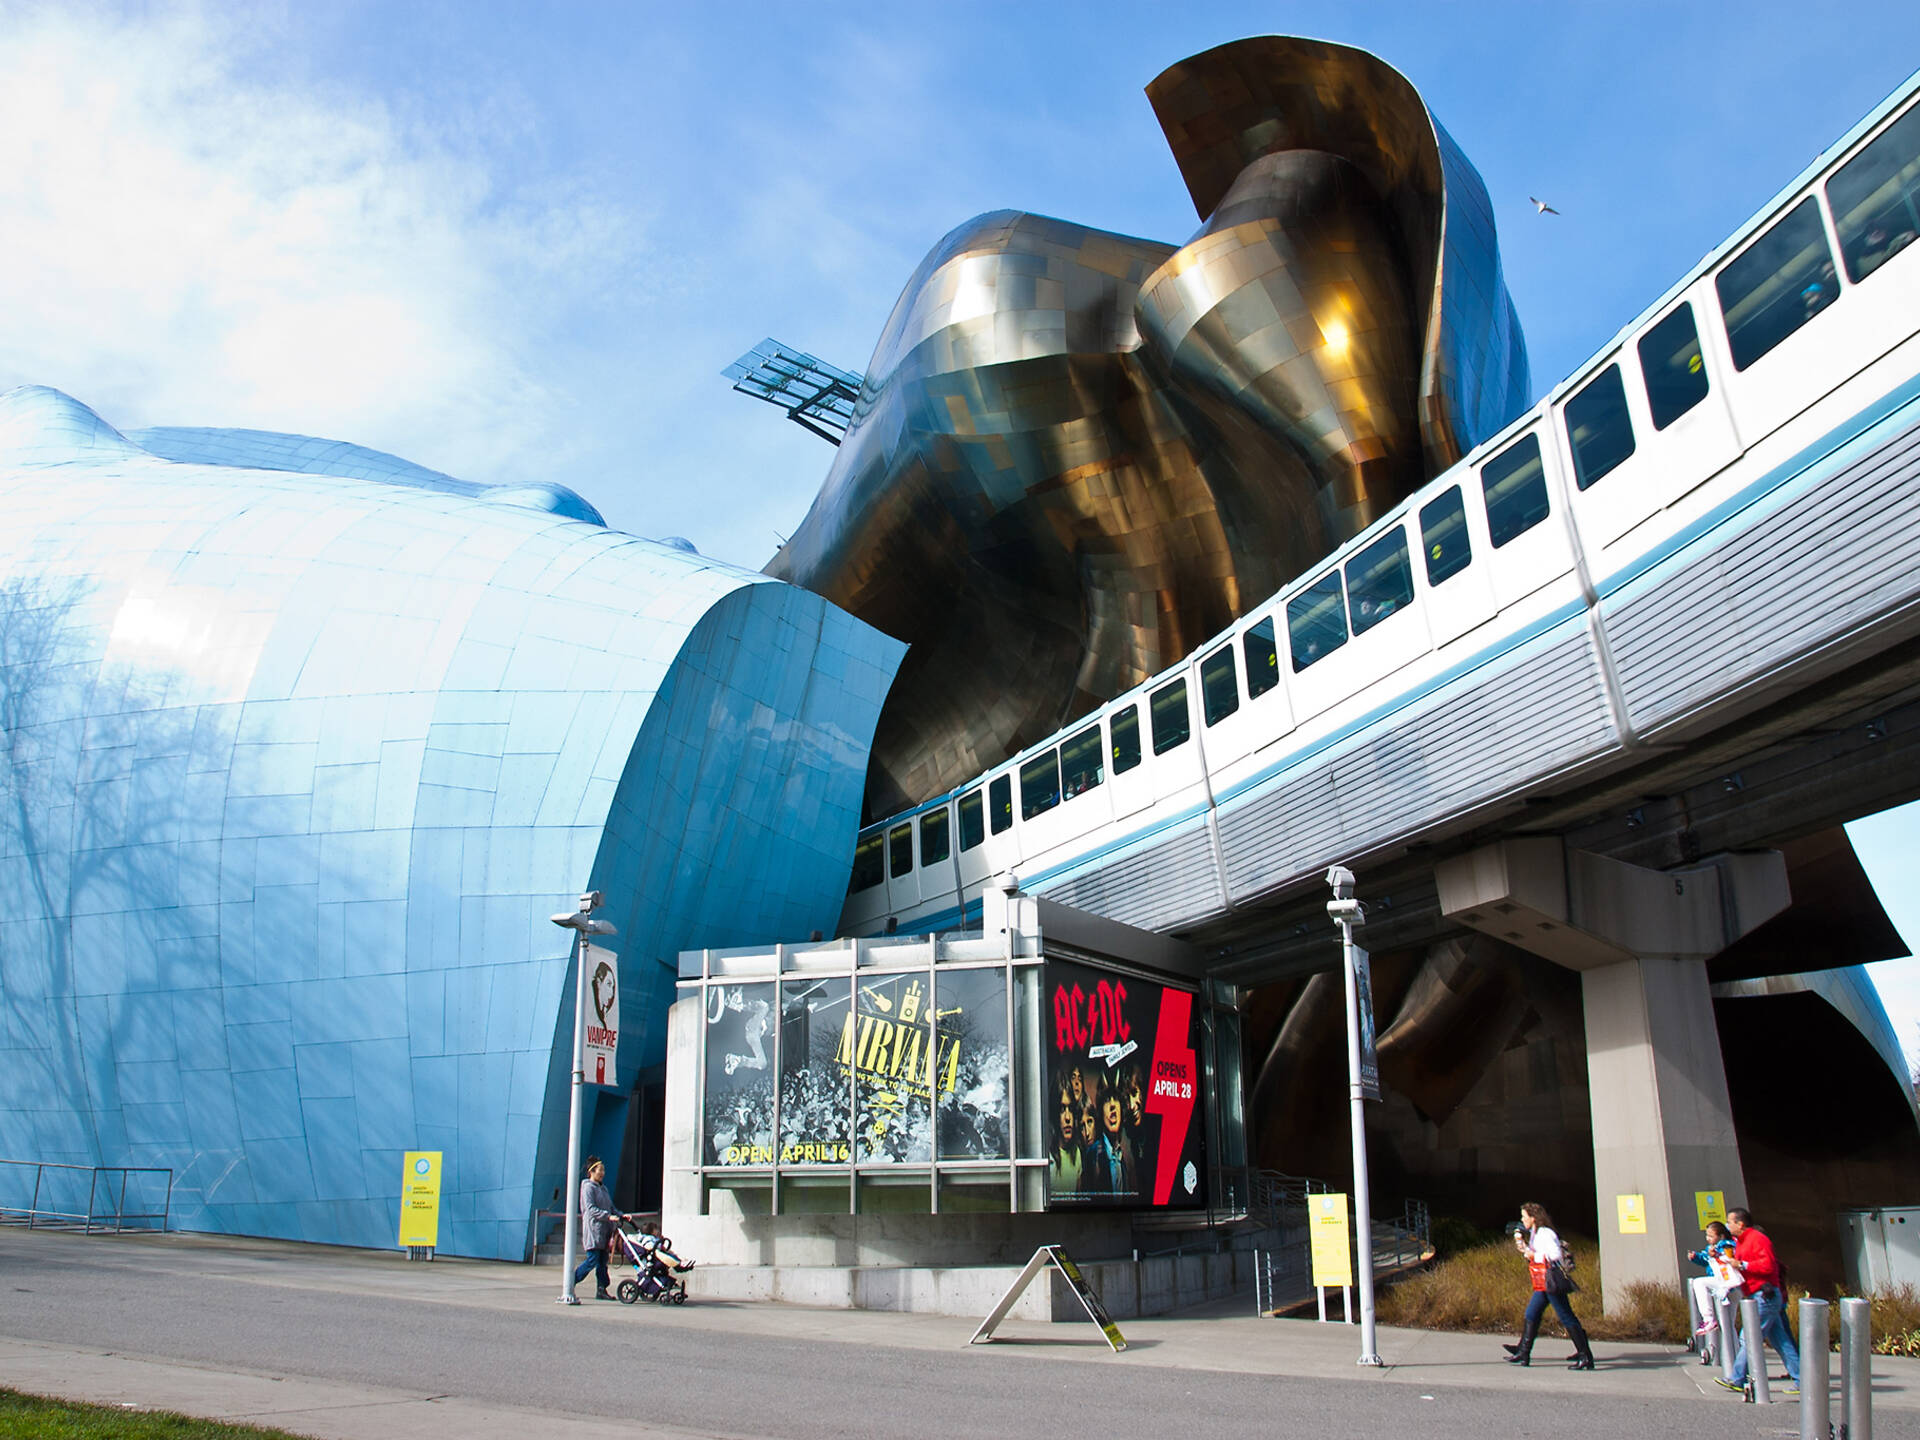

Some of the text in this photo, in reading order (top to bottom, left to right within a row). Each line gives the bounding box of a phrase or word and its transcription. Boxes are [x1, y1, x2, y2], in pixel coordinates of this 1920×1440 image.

[1675, 880, 1684, 896] 5
[834, 1011, 961, 1093] NIRVANA
[1157, 1061, 1187, 1079] OPENS
[889, 1079, 898, 1089] TO
[1154, 1080, 1192, 1099] APRIL 28
[727, 1143, 849, 1163] OPEN APRIL 16
